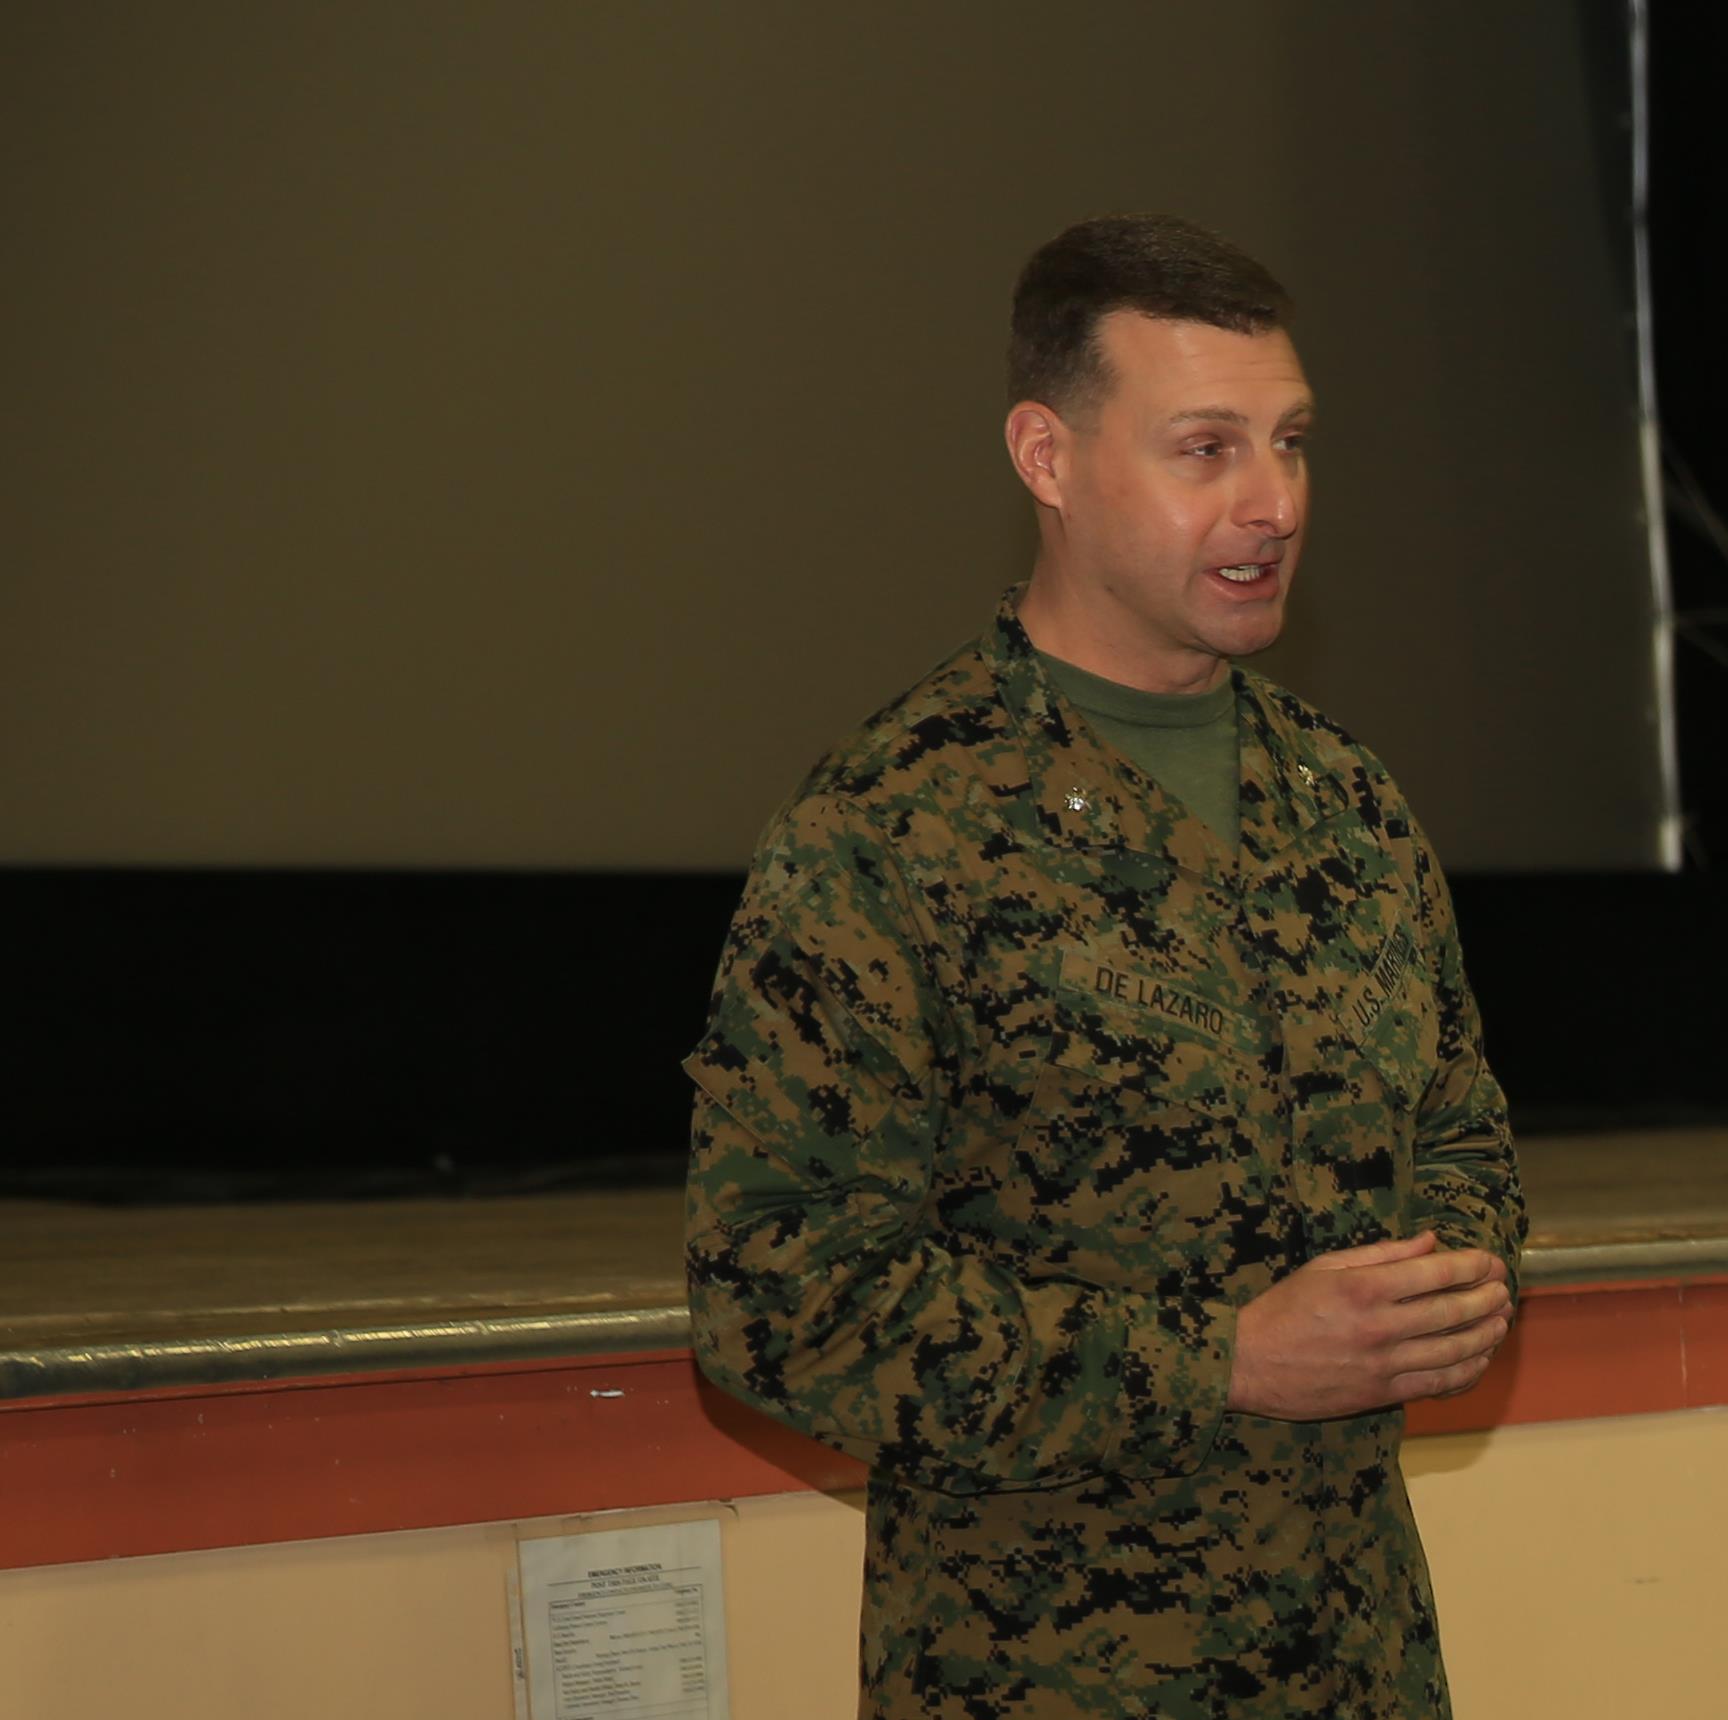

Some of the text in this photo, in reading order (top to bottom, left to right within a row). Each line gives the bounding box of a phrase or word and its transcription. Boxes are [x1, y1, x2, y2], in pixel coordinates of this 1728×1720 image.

[1095, 966, 1224, 1034] DE LAZARO
[1352, 982, 1383, 1027] U.S.
